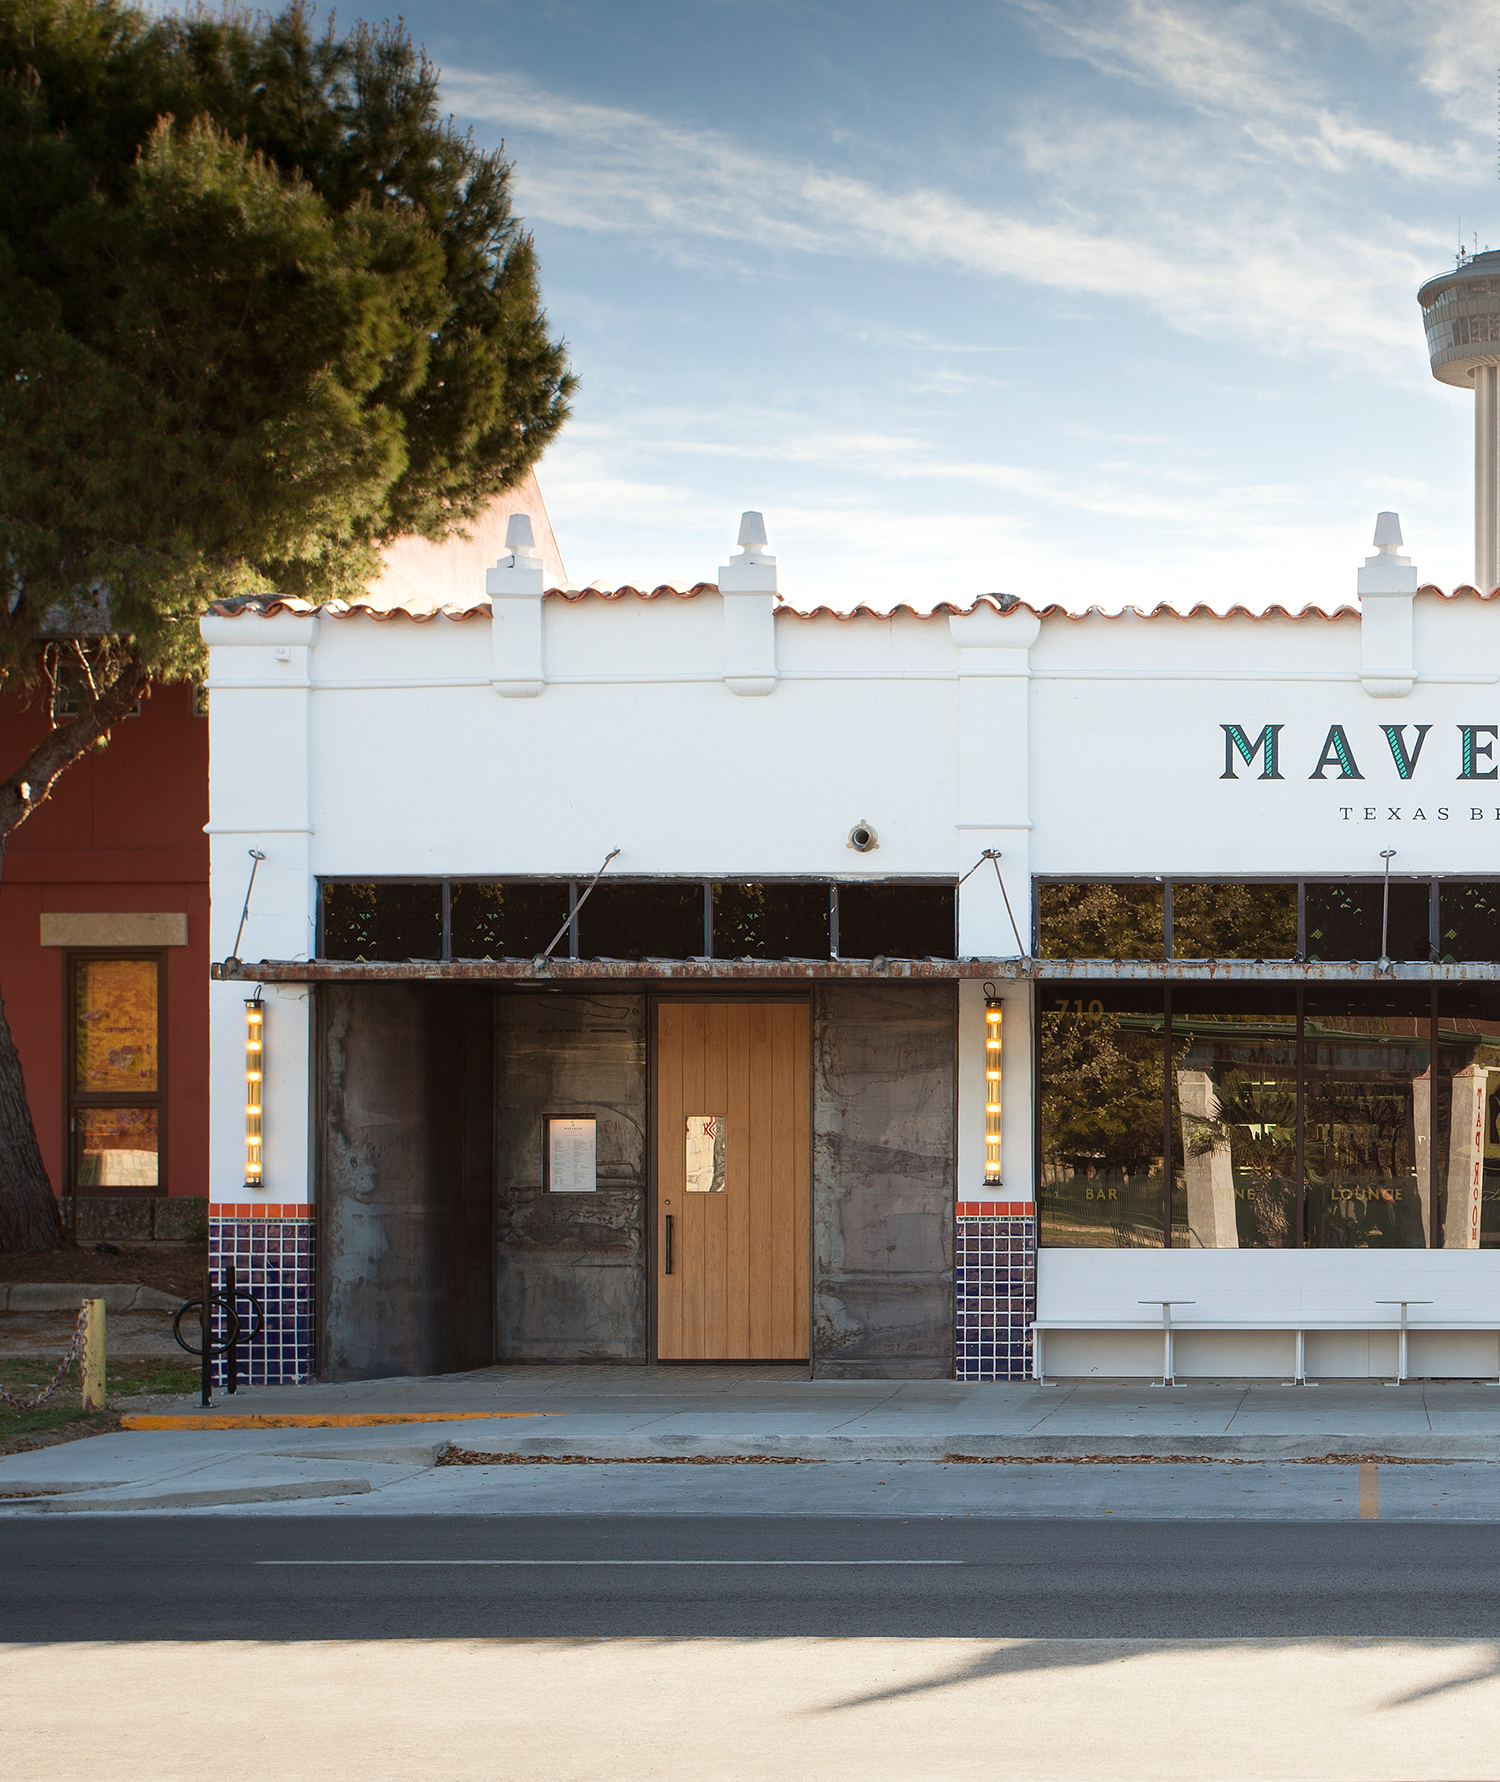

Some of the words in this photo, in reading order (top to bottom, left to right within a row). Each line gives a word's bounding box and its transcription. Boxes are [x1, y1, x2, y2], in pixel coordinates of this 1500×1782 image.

[1339, 807, 1450, 821] TEXAS
[1055, 999, 1105, 1022] 710
[1086, 1188, 1118, 1200] BAR
[1212, 1188, 1255, 1201] WINE
[1331, 1188, 1402, 1201] LOUNGE
